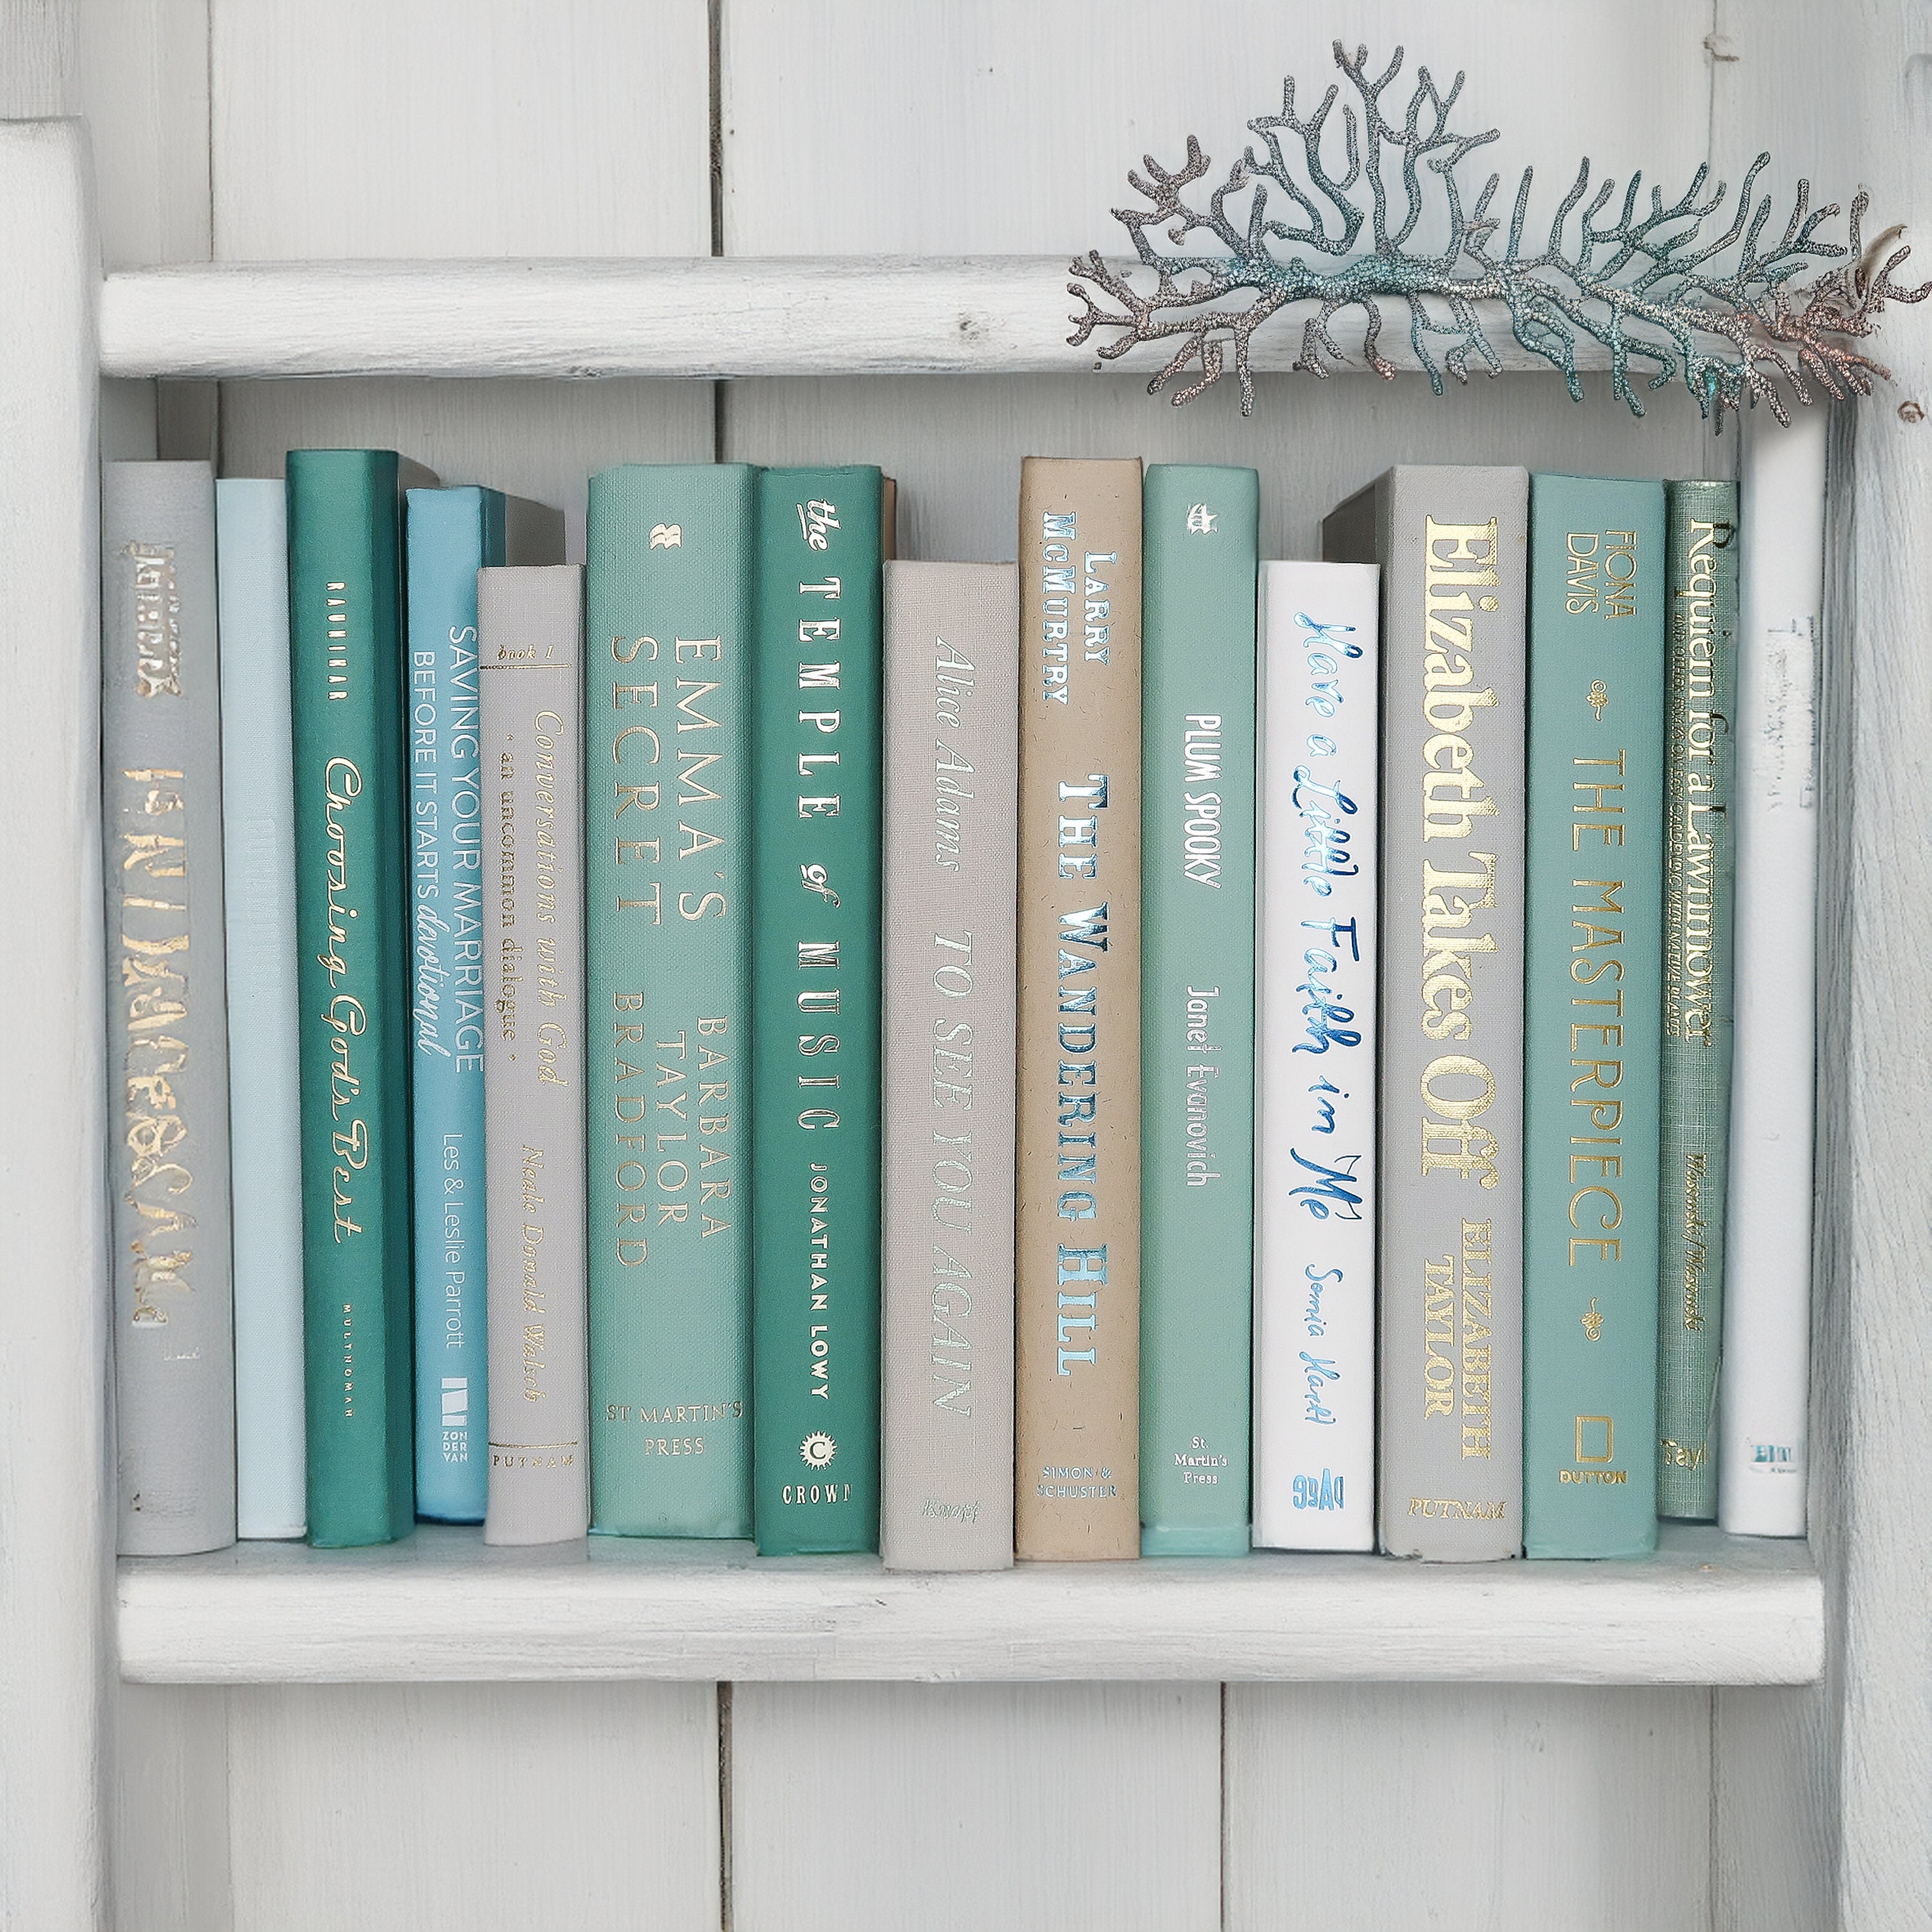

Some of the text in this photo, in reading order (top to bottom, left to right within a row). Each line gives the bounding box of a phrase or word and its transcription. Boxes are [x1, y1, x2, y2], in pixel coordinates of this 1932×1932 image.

[497, 644, 536, 659] book
[1566, 532, 1599, 614] DAVIS
[1605, 529, 1637, 620] FIONA
[449, 625, 484, 1072] SAVING YOUR MARRIAGE
[611, 636, 661, 925] SECRET
[675, 636, 727, 922] EMMA'S
[796, 498, 841, 1130] the TEMPLE of MUSIC
[934, 636, 976, 873] Alice Adams
[1182, 714, 1222, 889] PLUM SPOOKY
[1419, 515, 1501, 1189] Elizabeth Takes Off
[1674, 518, 1736, 1046] Requiem for a Lawnmower
[413, 651, 452, 1056] BEFORE IT STARTS devotional
[495, 753, 522, 1041] an uncommon dialogue
[534, 711, 569, 1086] Conversations with God
[1289, 612, 1364, 1220] Have a Little Faith in Me
[316, 757, 368, 1243] Choosing God's Best
[1185, 985, 1222, 1188] Janet Evanovich
[1567, 748, 1625, 1267] THE MASTERPIECE
[522, 1144, 545, 1214] Neale
[613, 992, 648, 1268] BRADFORD
[655, 1030, 689, 1227] TAYLOR
[696, 1016, 731, 1240] BARBARA
[931, 930, 974, 1417] TO SEE YOU AGAIN
[442, 1133, 467, 1349] Les & Leslie Parrott
[522, 1224, 546, 1314] Donald
[810, 1163, 829, 1401] JONATHAN LOWY
[1303, 1264, 1343, 1337] Sonia
[1423, 1254, 1455, 1421] TAYLOR
[1461, 1217, 1493, 1461] ELIZABETH
[343, 1304, 353, 1417] MULTNOMAH
[442, 1431, 468, 1441] ZON
[442, 1442, 467, 1452] DER
[442, 1452, 468, 1463] VAN
[645, 1437, 705, 1456] PRESS
[1191, 1435, 1209, 1449] St.
[1037, 1484, 1117, 1498] SCHUSTER
[1043, 1466, 1112, 1479] SIMON &
[1174, 1453, 1228, 1467] Martin's
[1184, 1472, 1218, 1484] Press
[1408, 1497, 1507, 1519] PUTNAM
[1559, 1470, 1627, 1484] DUTTON
